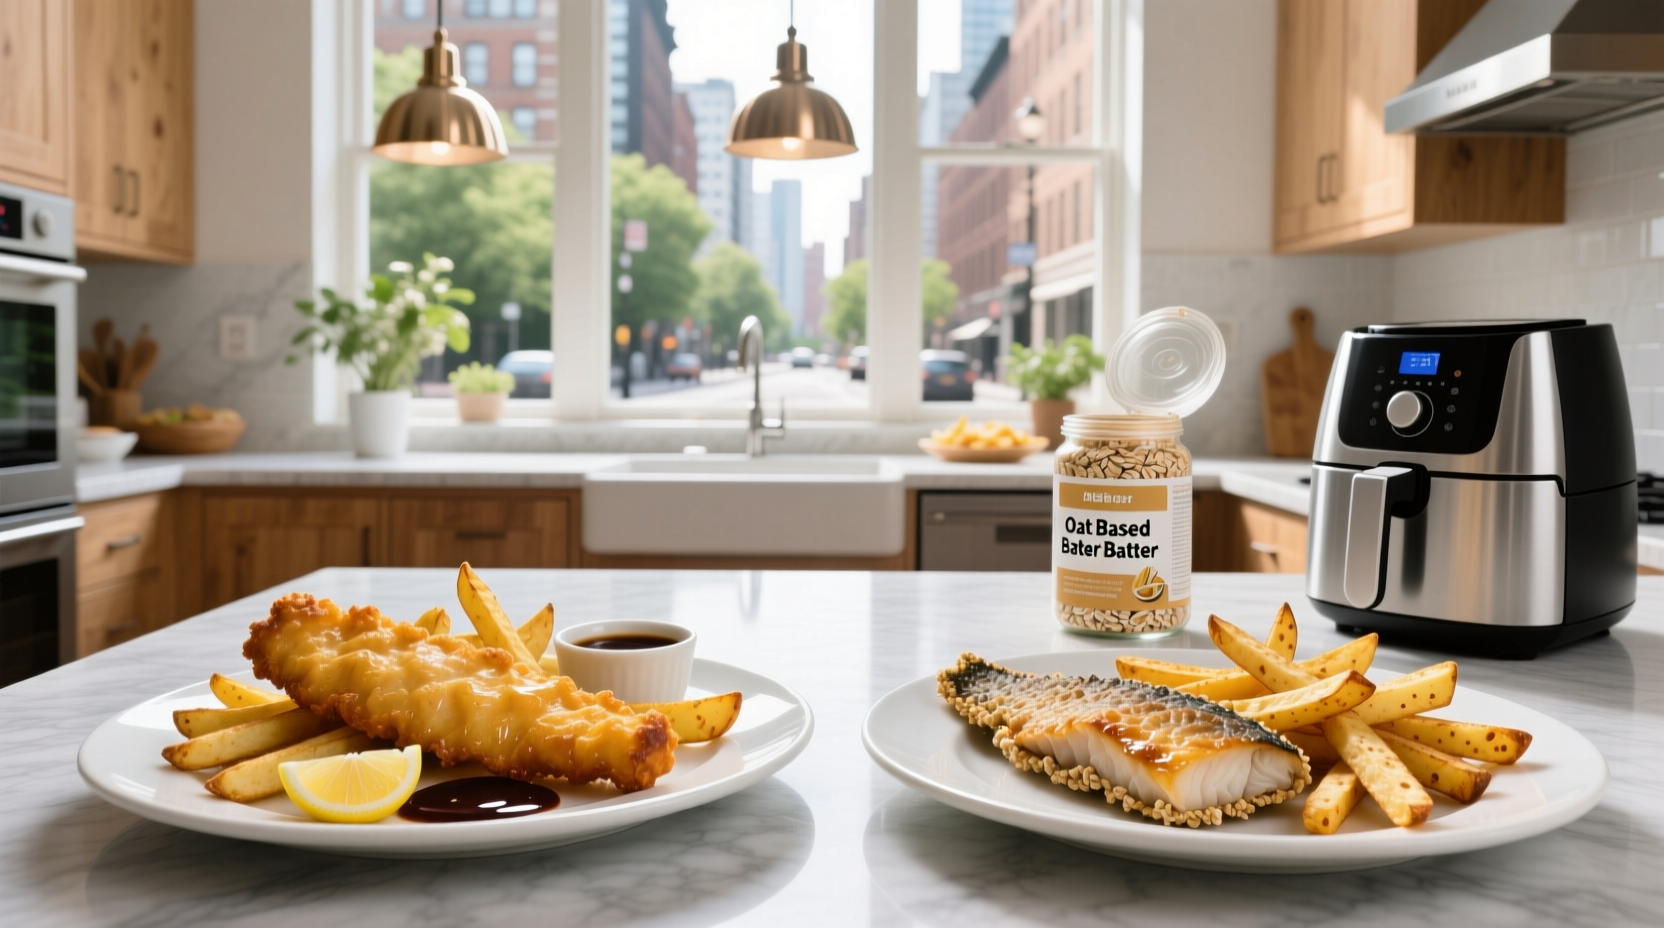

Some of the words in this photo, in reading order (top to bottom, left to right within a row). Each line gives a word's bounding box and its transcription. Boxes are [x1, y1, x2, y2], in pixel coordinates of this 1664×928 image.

[1065, 516, 1093, 535] Oat
[1096, 519, 1150, 537] Based
[1061, 537, 1101, 557] Bater
[1104, 541, 1158, 559] Batter
